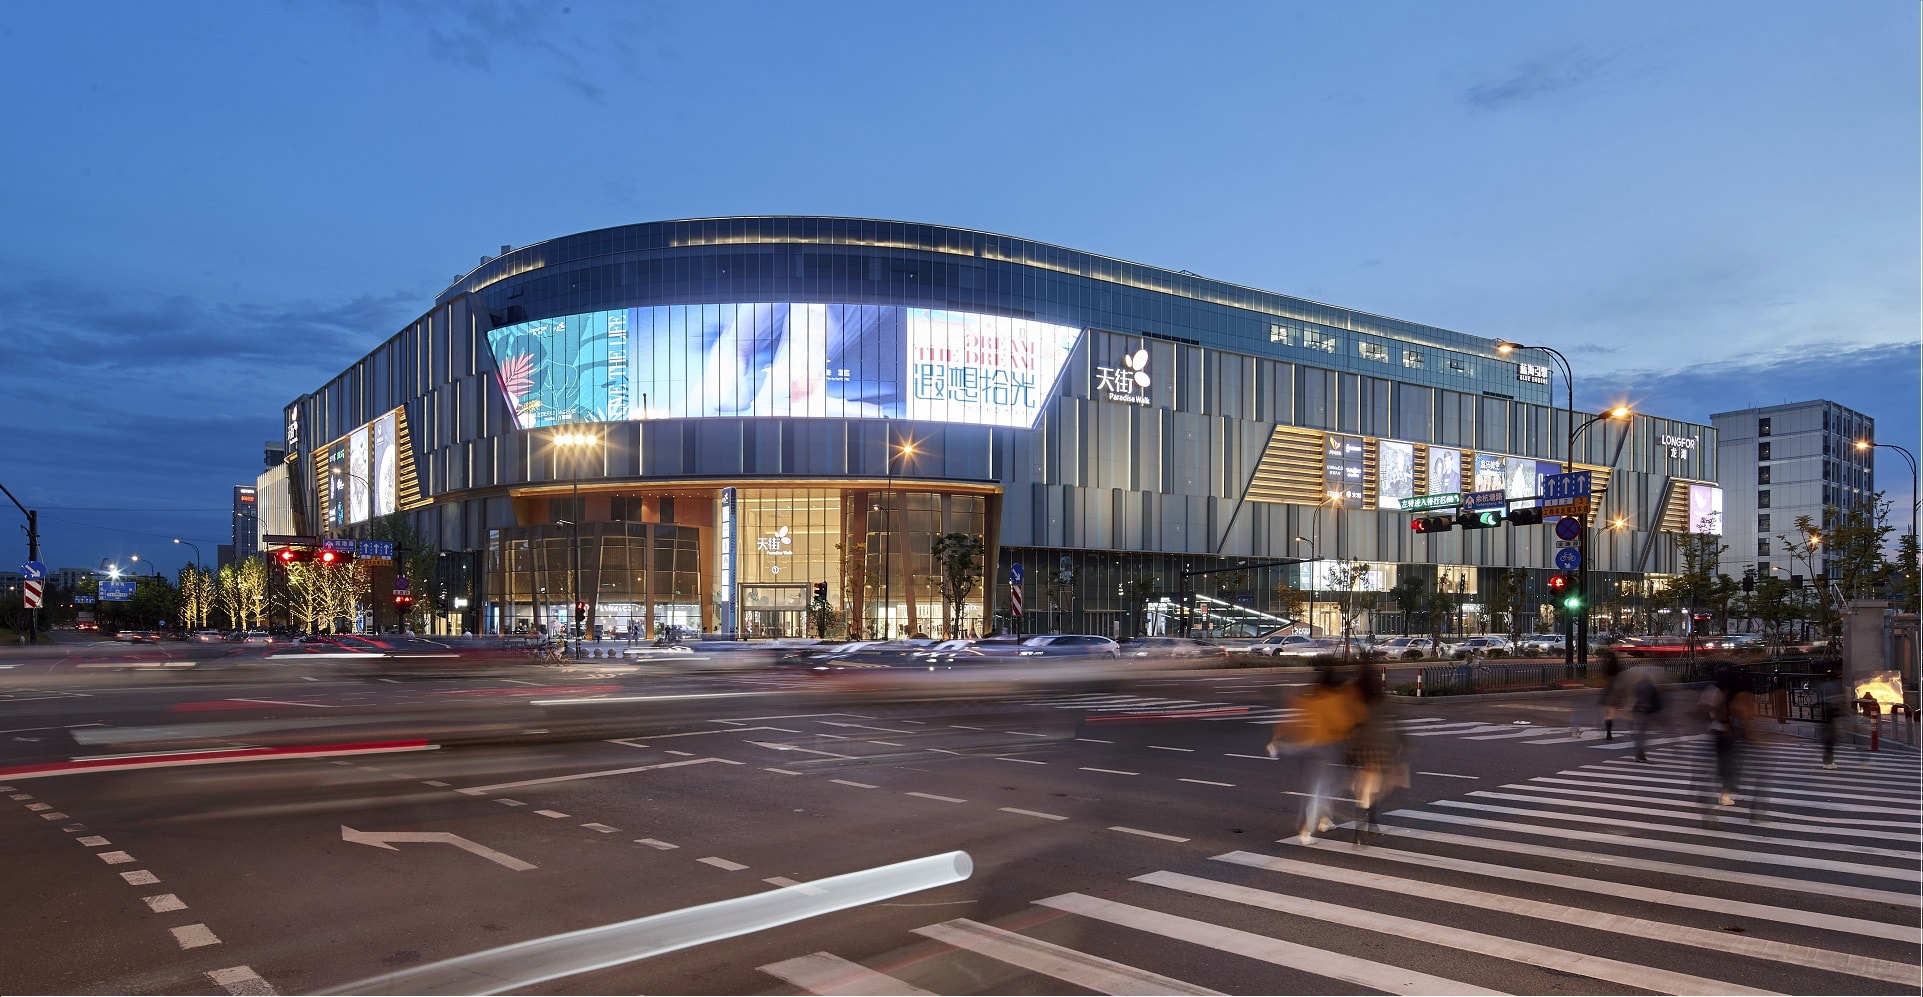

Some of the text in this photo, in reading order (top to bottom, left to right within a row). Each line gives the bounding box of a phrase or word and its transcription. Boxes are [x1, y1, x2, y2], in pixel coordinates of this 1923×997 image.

[608, 314, 627, 346] LIFE
[608, 349, 627, 380] THE
[966, 350, 1035, 370] DREAM
[1096, 366, 1134, 394] 天街
[1520, 374, 1532, 382] BLUE
[1109, 392, 1151, 405] Paradise Walk
[1661, 434, 1696, 450] LONGFOR
[756, 536, 780, 551] 天街
